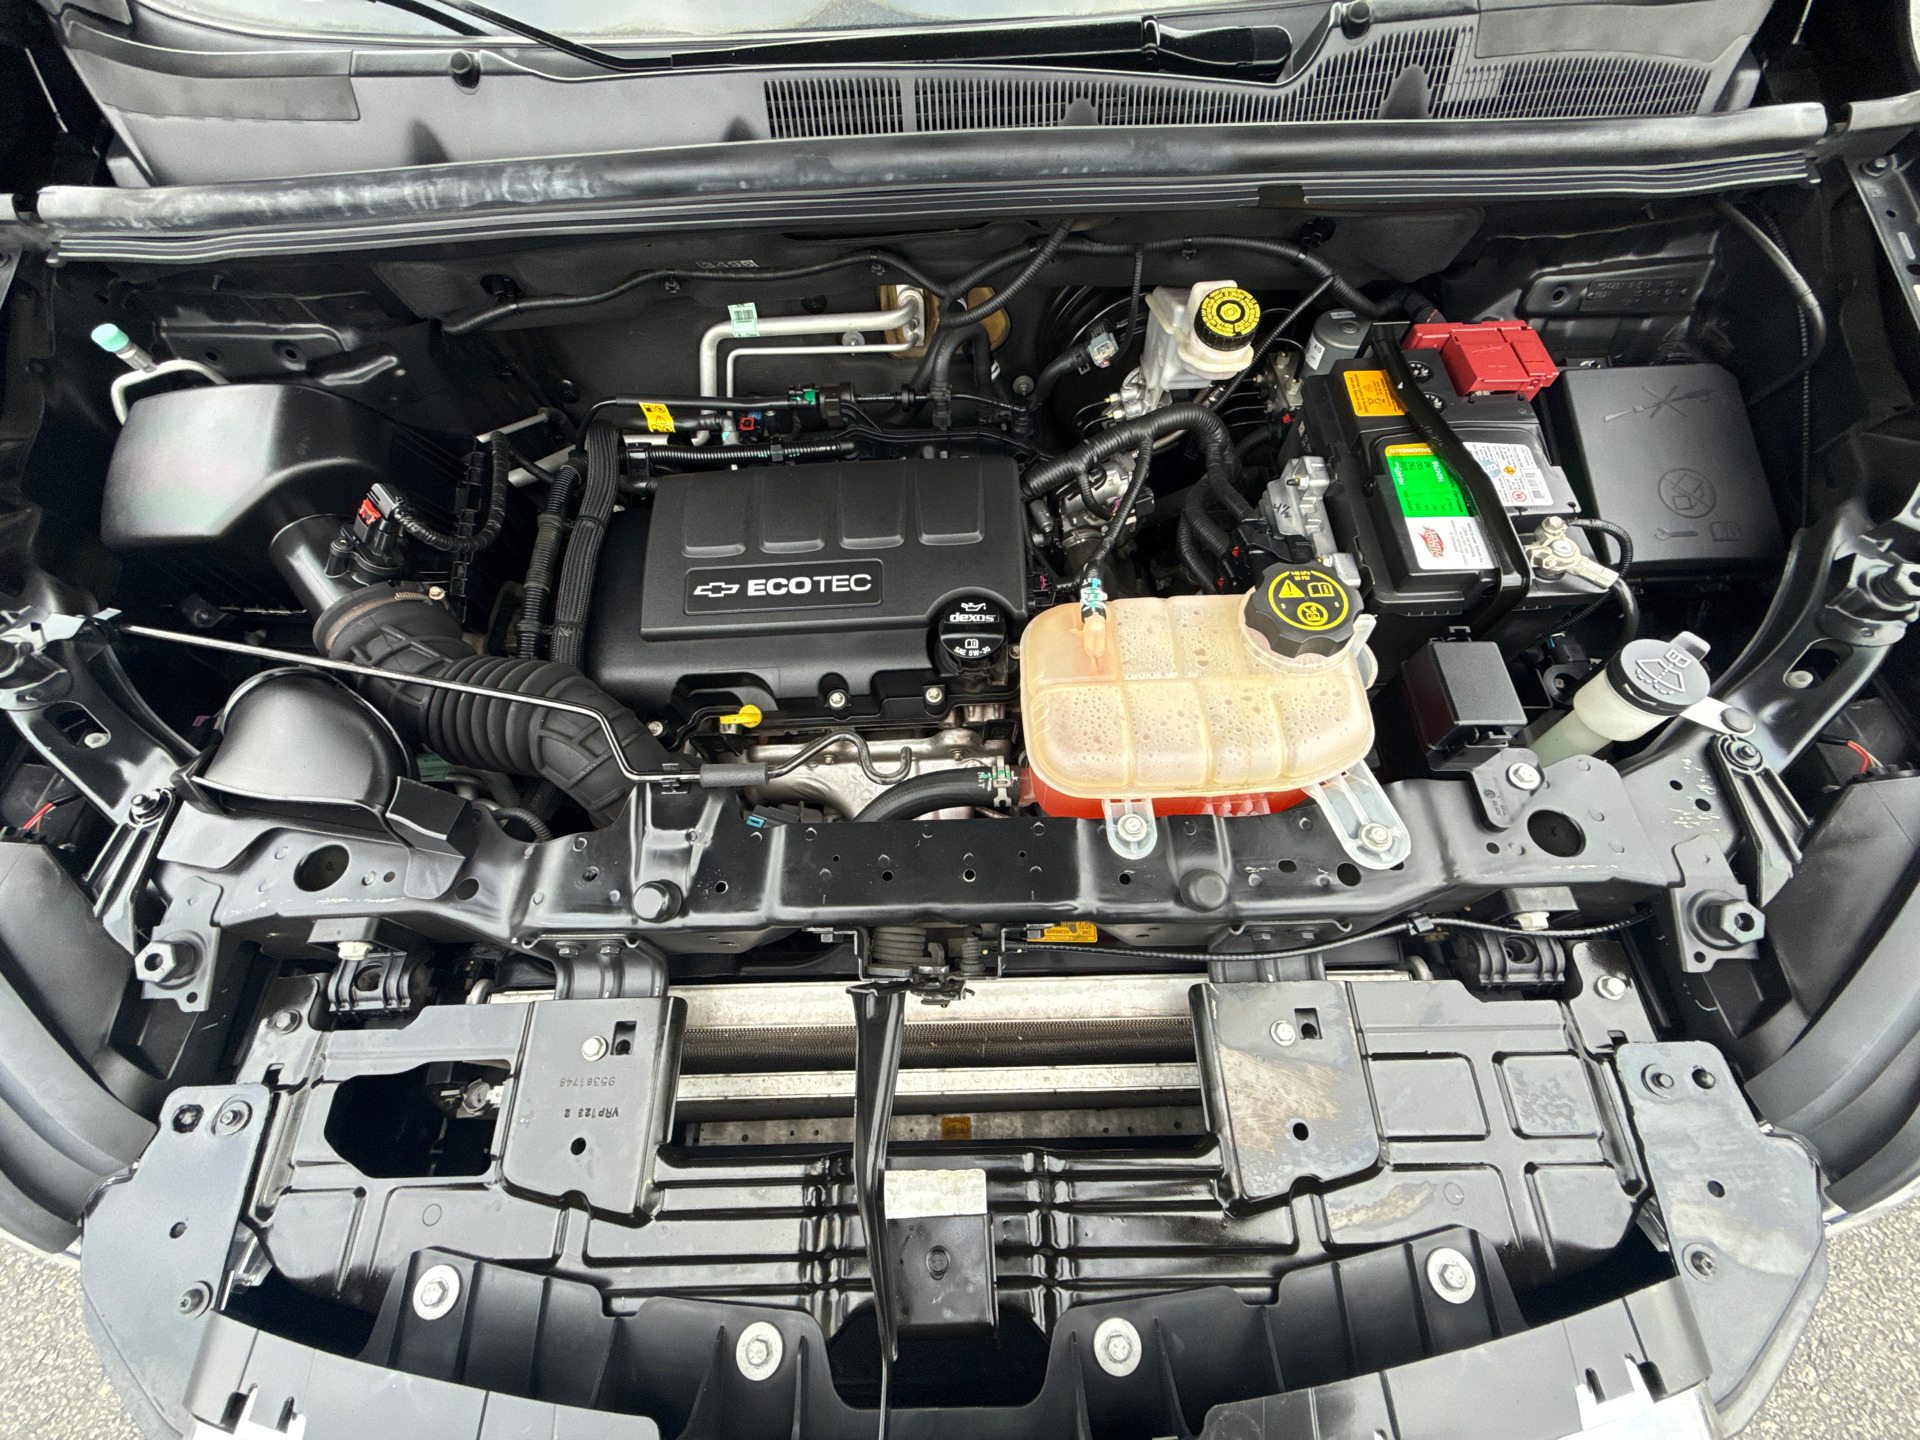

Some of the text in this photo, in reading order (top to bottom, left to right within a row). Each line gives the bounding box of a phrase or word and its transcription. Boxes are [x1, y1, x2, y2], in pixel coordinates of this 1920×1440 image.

[747, 574, 872, 596] ECOTEC
[949, 612, 996, 622] dexos
[954, 646, 991, 656] SAE 5W-30
[560, 1077, 616, 1087] 95381748
